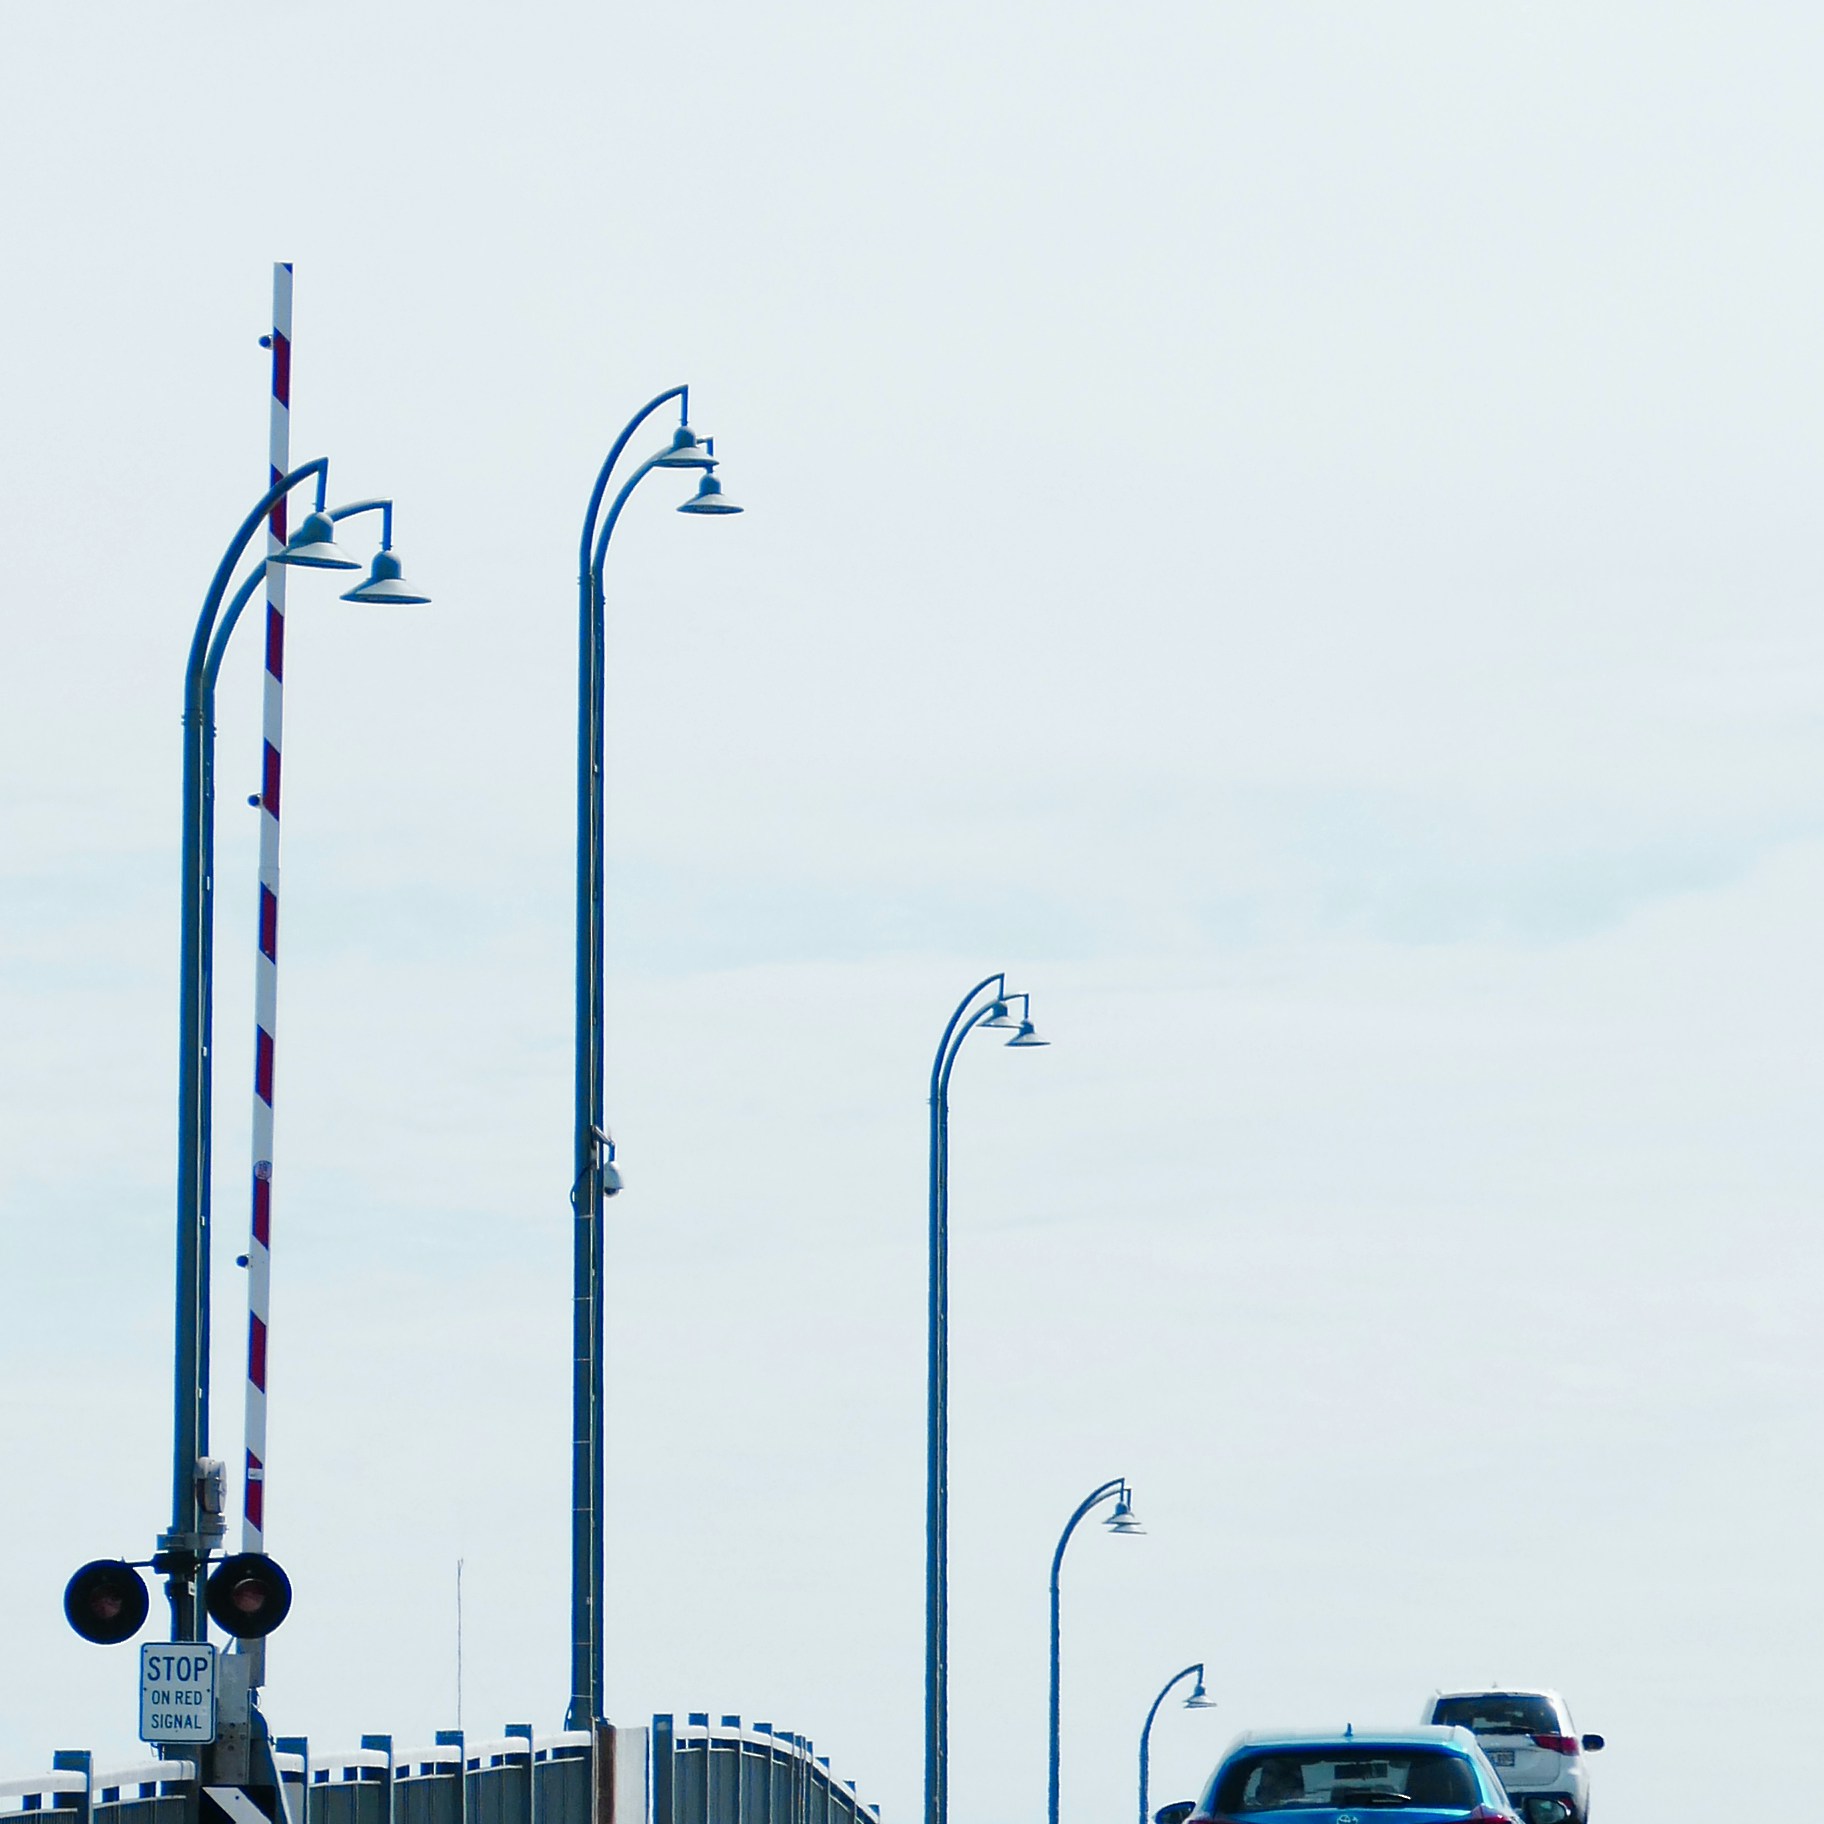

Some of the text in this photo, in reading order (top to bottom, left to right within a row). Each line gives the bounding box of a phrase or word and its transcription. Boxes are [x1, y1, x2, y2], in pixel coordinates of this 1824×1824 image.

[147, 1656, 208, 1681] STOP
[151, 1689, 203, 1705] ON RED
[151, 1714, 202, 1729] SIGNAL
